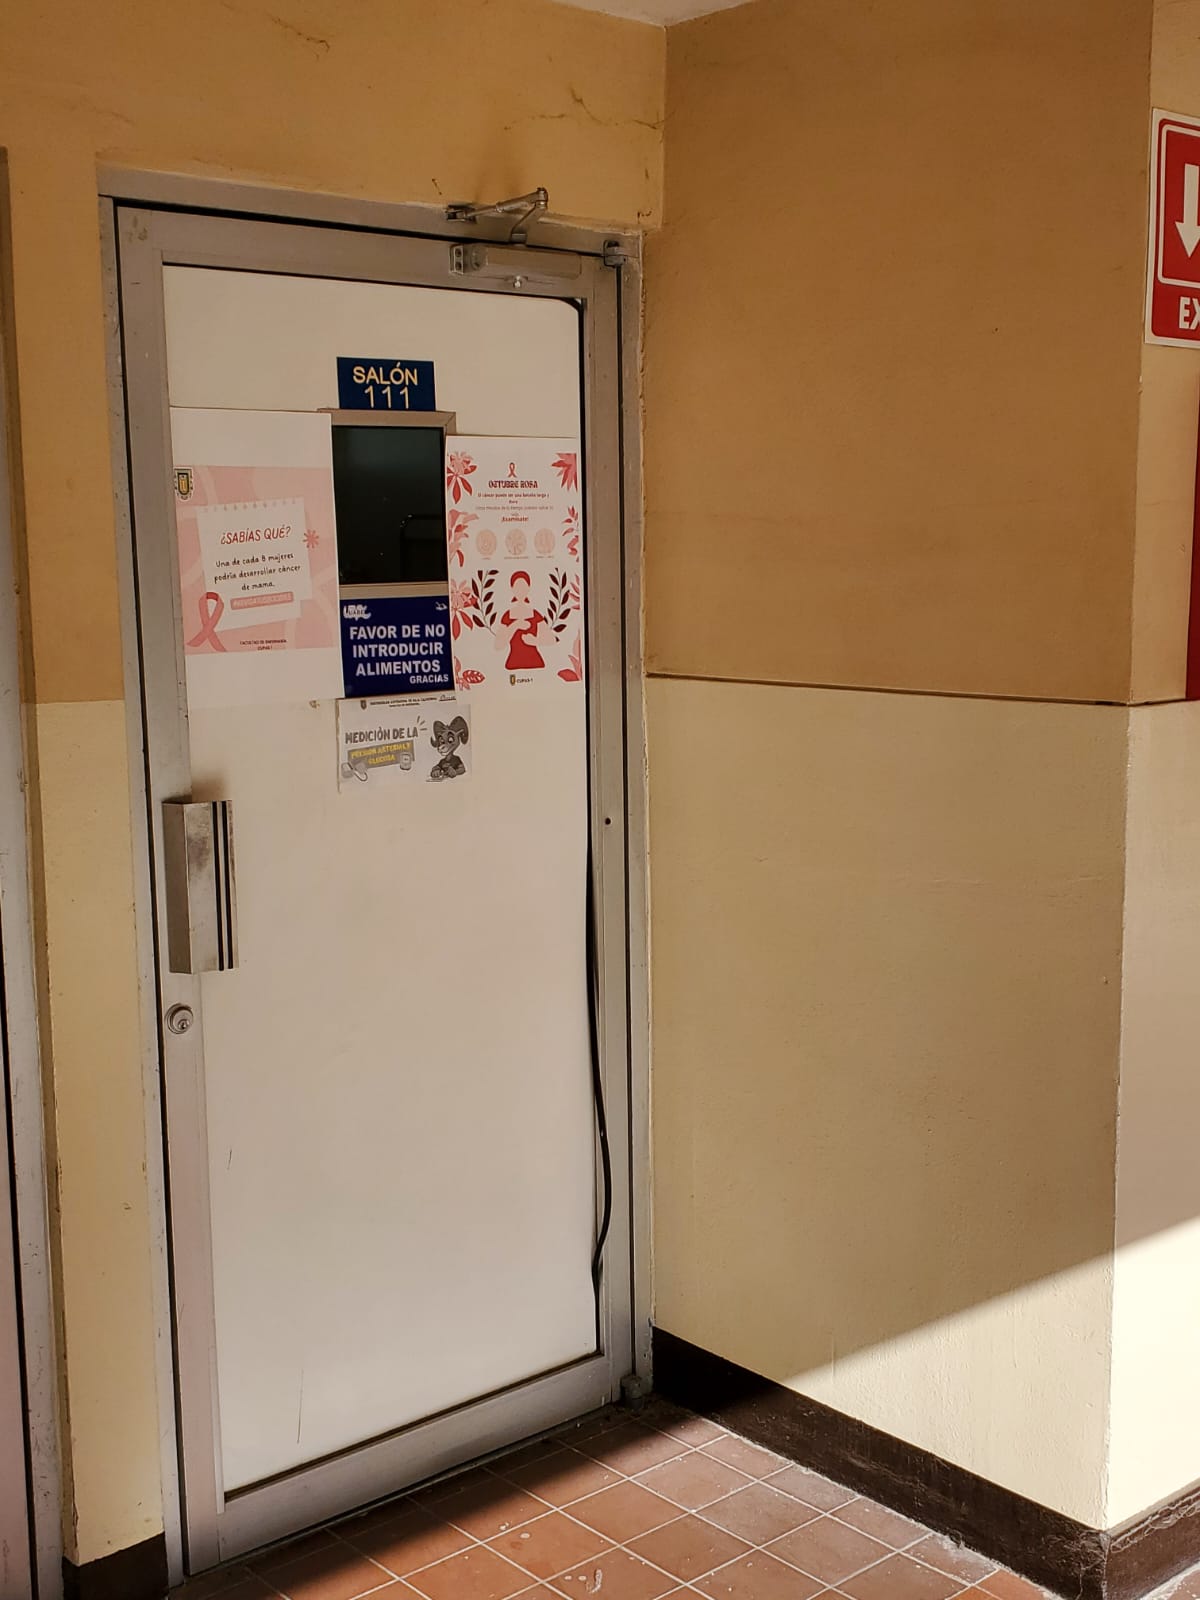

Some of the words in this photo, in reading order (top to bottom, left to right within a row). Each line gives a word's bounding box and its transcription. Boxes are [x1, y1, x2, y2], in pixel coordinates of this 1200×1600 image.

[353, 361, 418, 386] SALÓN
[364, 385, 409, 409] 111
[220, 528, 261, 545] ¿SABÍAS
[264, 524, 291, 540] QUÉ?
[232, 558, 240, 566] de
[242, 556, 259, 565] cada
[268, 553, 294, 563] mujeres
[238, 567, 276, 578] desarrollar
[349, 625, 397, 640] FAVOR
[401, 624, 420, 638] DE
[425, 624, 446, 638] NO
[352, 642, 444, 658] INTRODUCIR
[355, 659, 441, 677] ALIMENTOS
[409, 674, 449, 684] GRACIAS
[345, 726, 391, 744] MEDICIÓN
[392, 728, 405, 740] DE
[407, 726, 419, 738] LA
